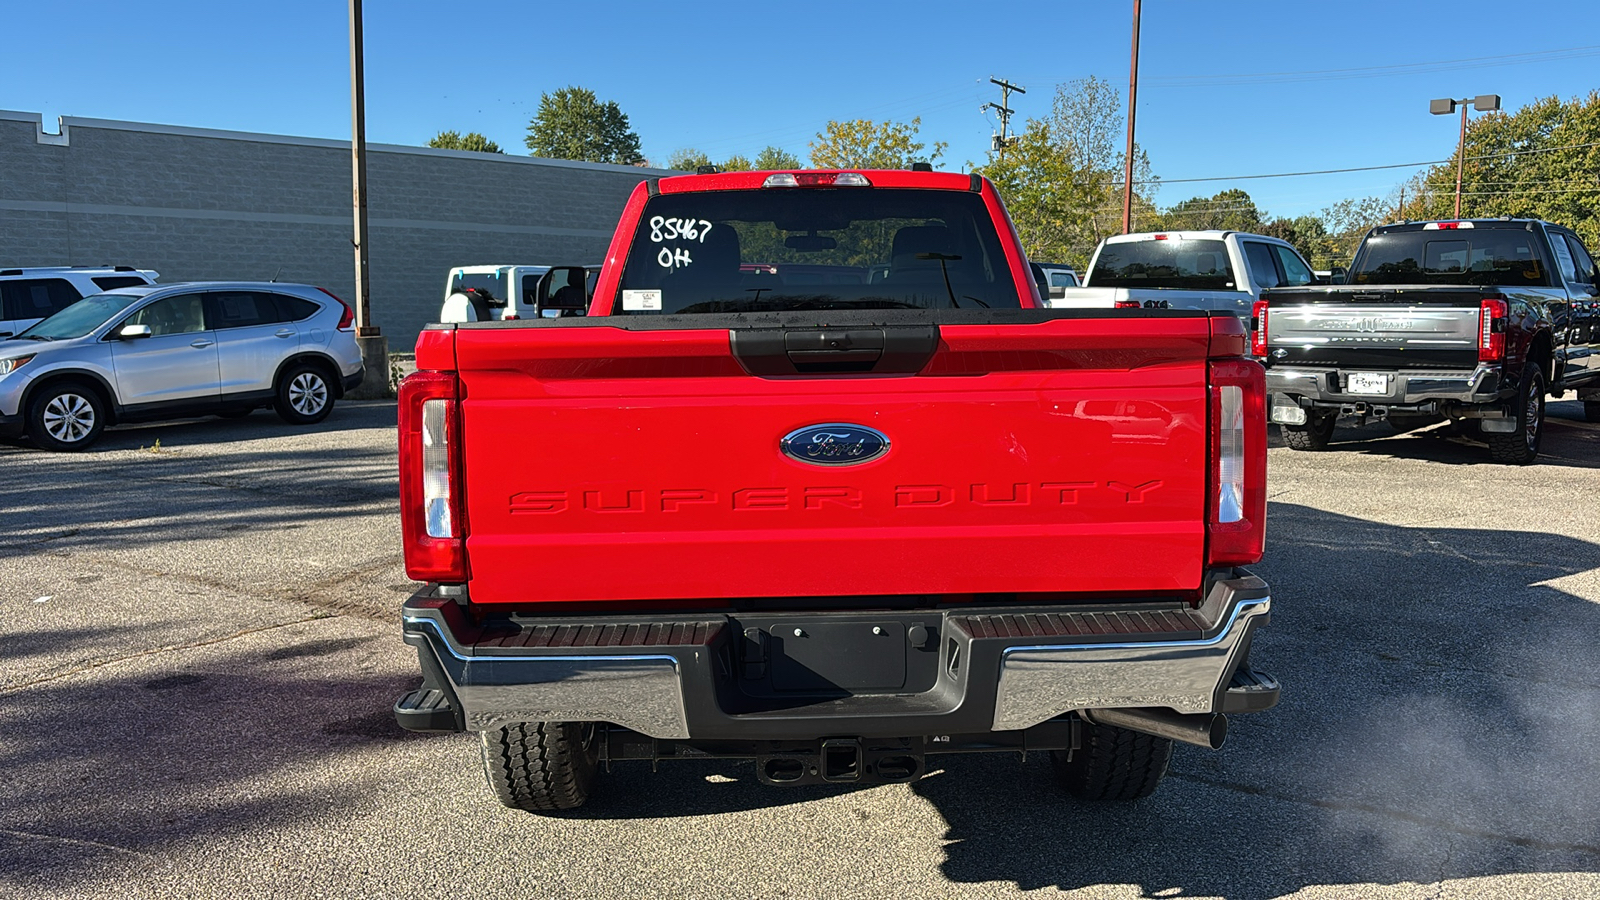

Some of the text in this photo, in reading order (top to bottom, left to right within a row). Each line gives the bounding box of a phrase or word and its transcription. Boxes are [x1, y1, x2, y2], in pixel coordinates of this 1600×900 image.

[649, 215, 712, 243] 85467
[807, 432, 865, 457] Ford
[508, 479, 1164, 515] SUPER DUTY
